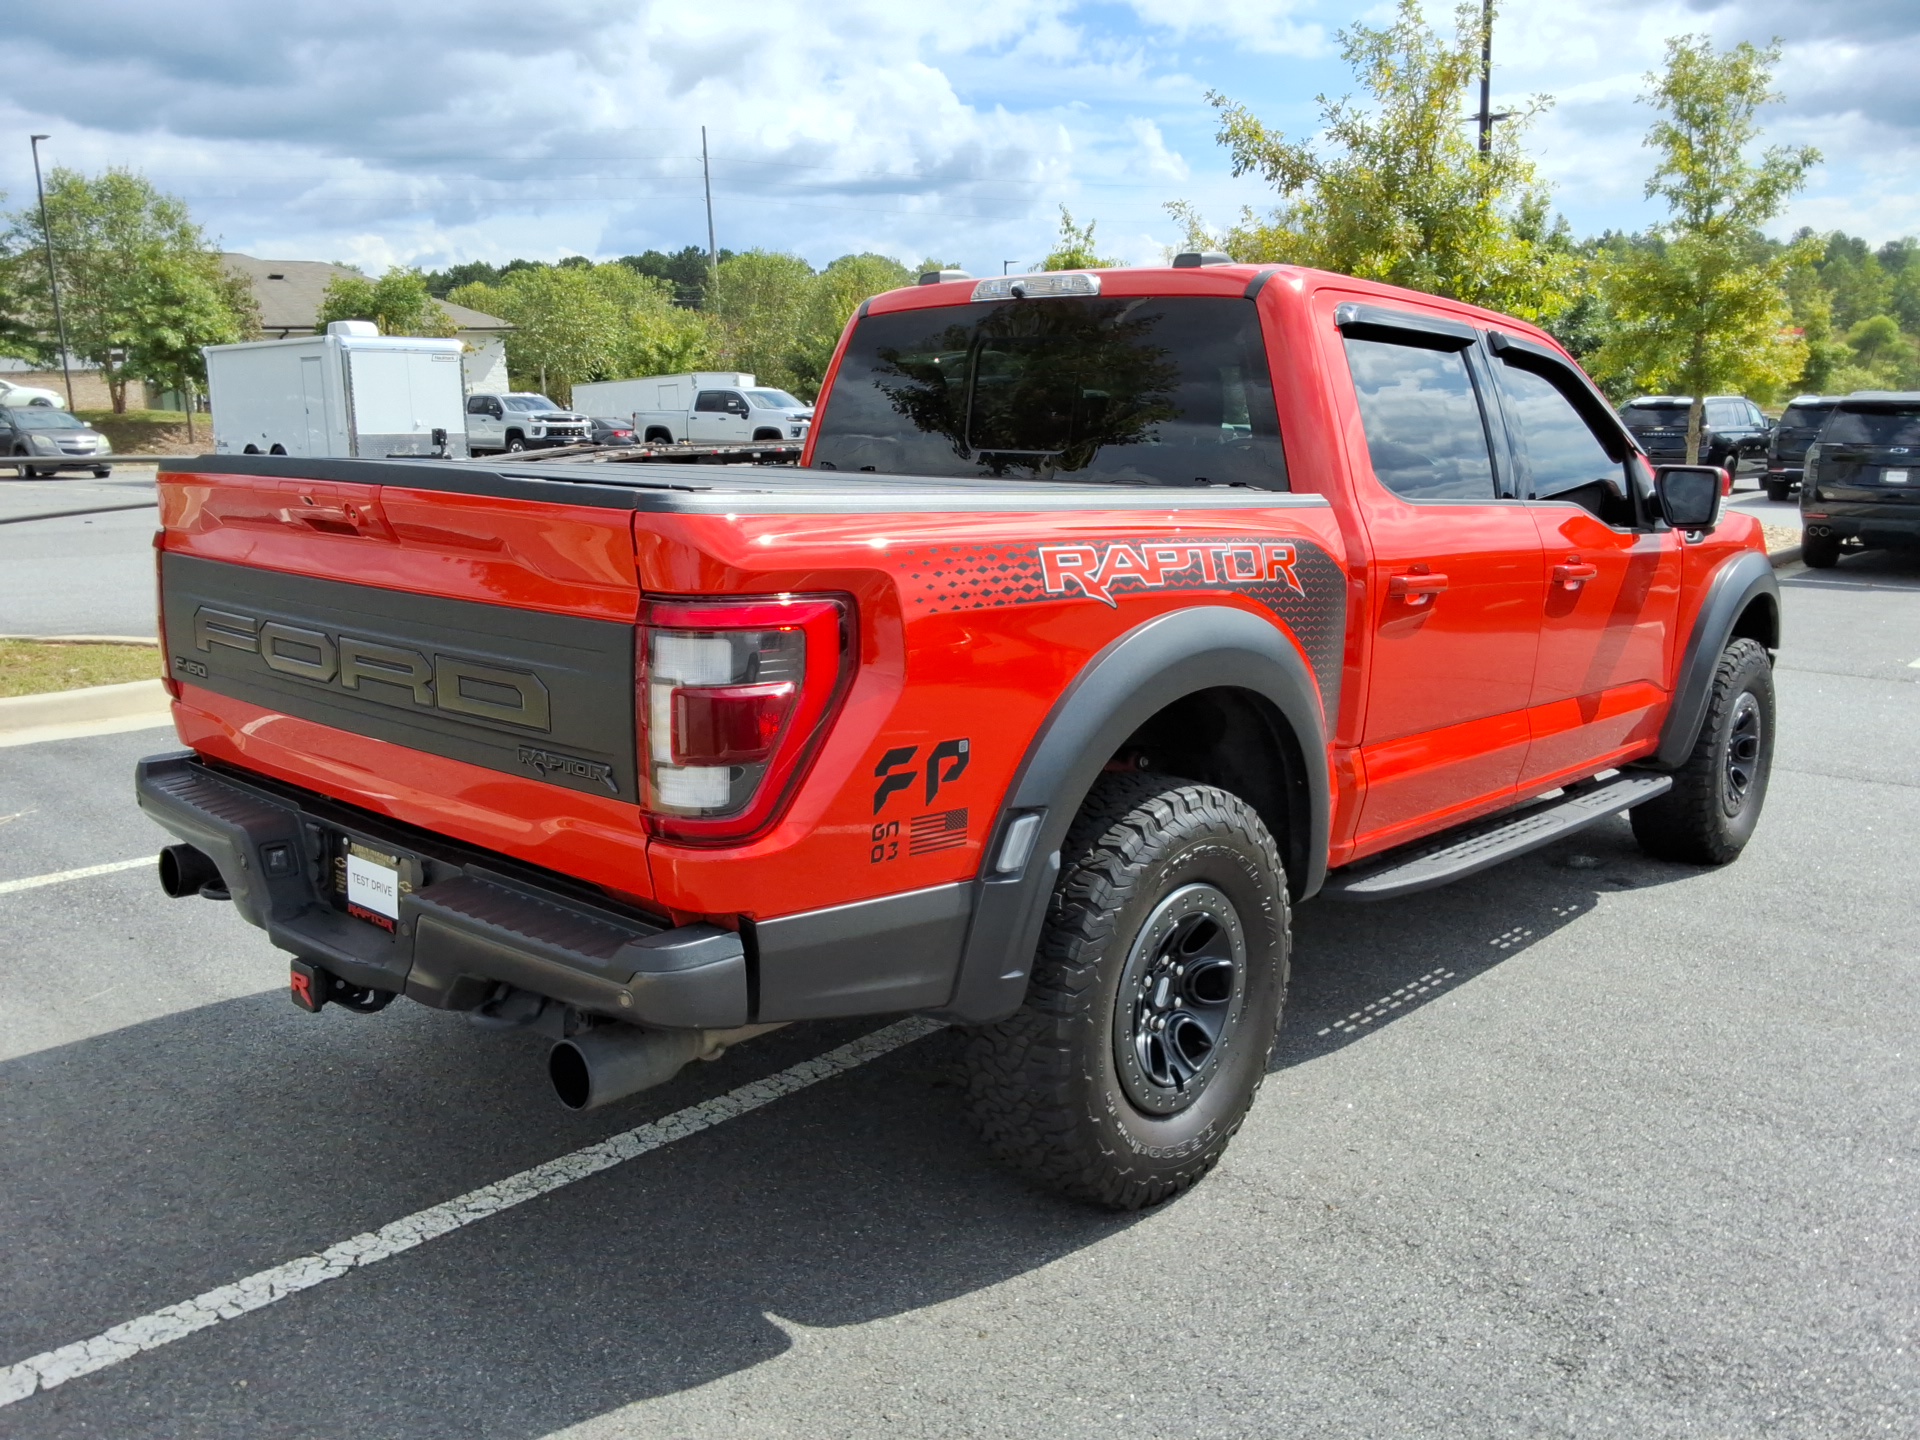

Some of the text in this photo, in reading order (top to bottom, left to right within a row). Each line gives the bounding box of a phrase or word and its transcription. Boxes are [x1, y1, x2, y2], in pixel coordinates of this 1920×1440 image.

[1038, 543, 1306, 608] RAPTOR
[175, 656, 208, 679] F-150
[194, 605, 551, 733] FORD
[517, 745, 619, 794] RAPTOR
[352, 872, 370, 888] TEST
[371, 880, 393, 897] DRIVE
[291, 971, 314, 1008] R
